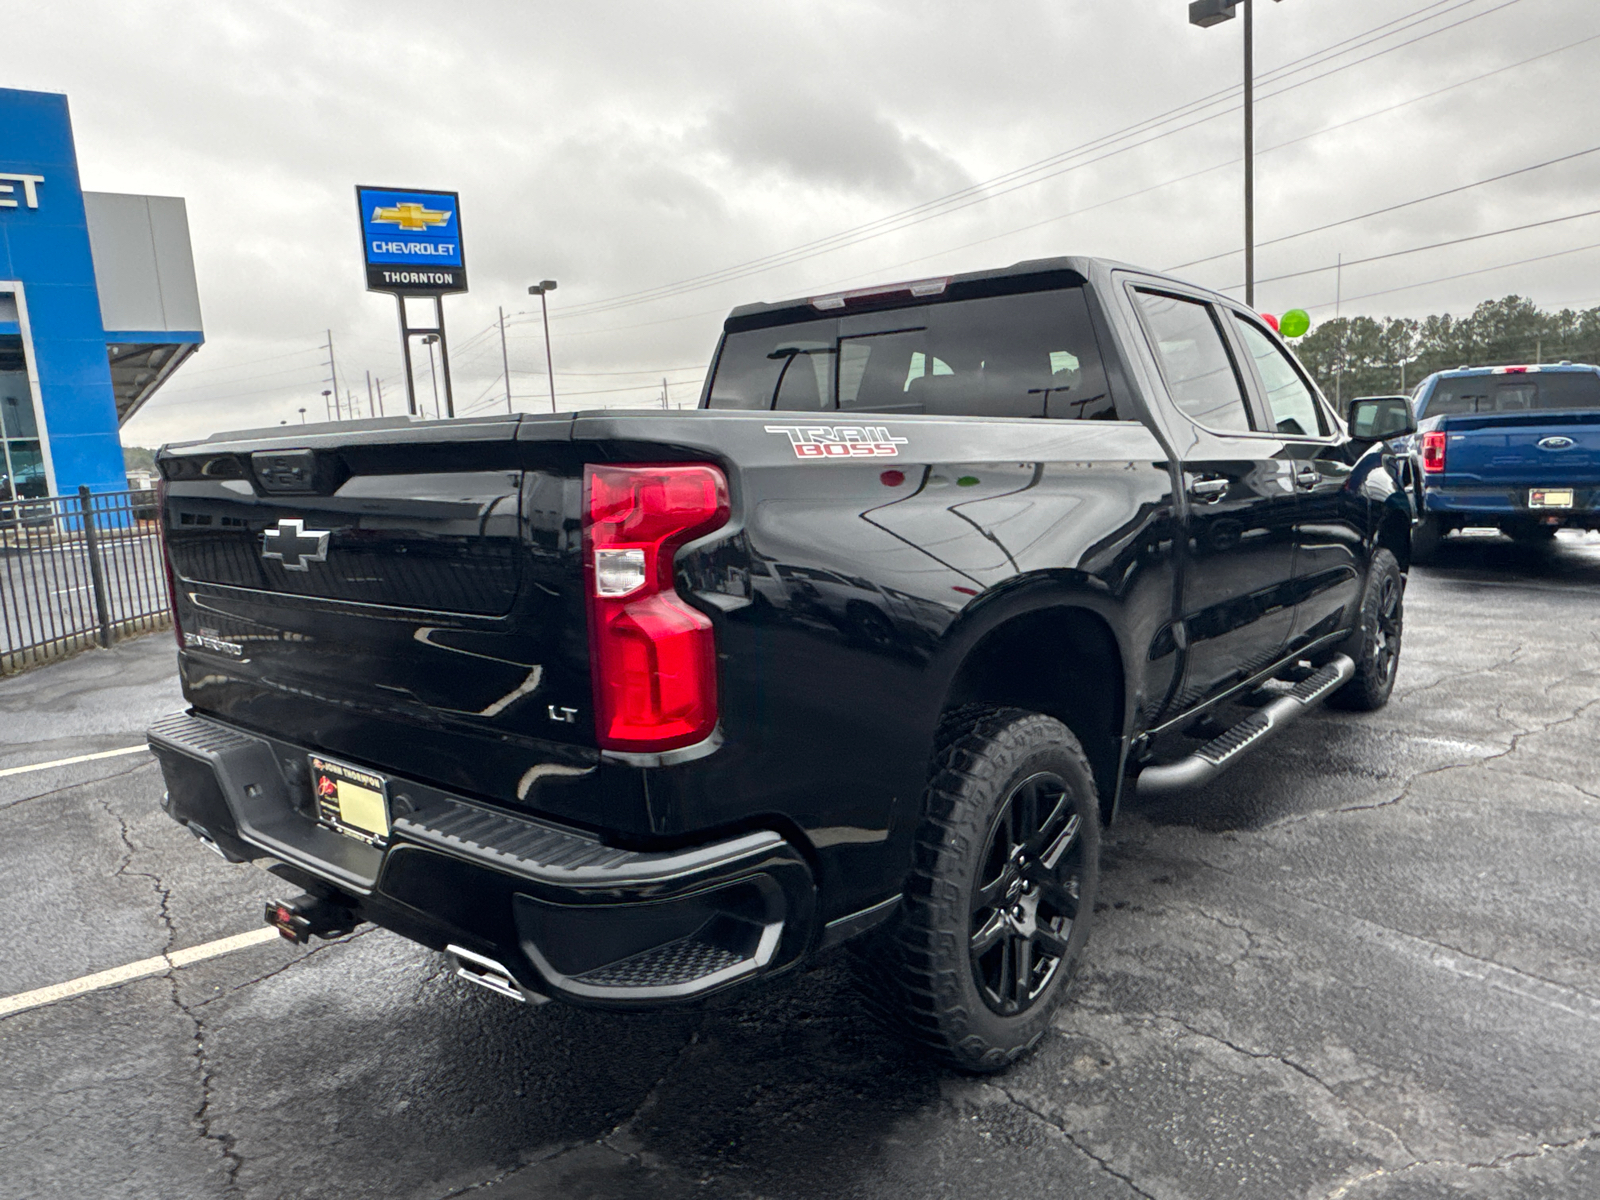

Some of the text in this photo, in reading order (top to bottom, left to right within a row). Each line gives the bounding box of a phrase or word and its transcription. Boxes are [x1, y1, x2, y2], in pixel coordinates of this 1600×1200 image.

[372, 241, 455, 256] CHEVROLET
[383, 271, 453, 284] THORNTON
[764, 425, 909, 444] TRAIL
[793, 442, 899, 458] BOSS
[548, 705, 578, 723] LT
